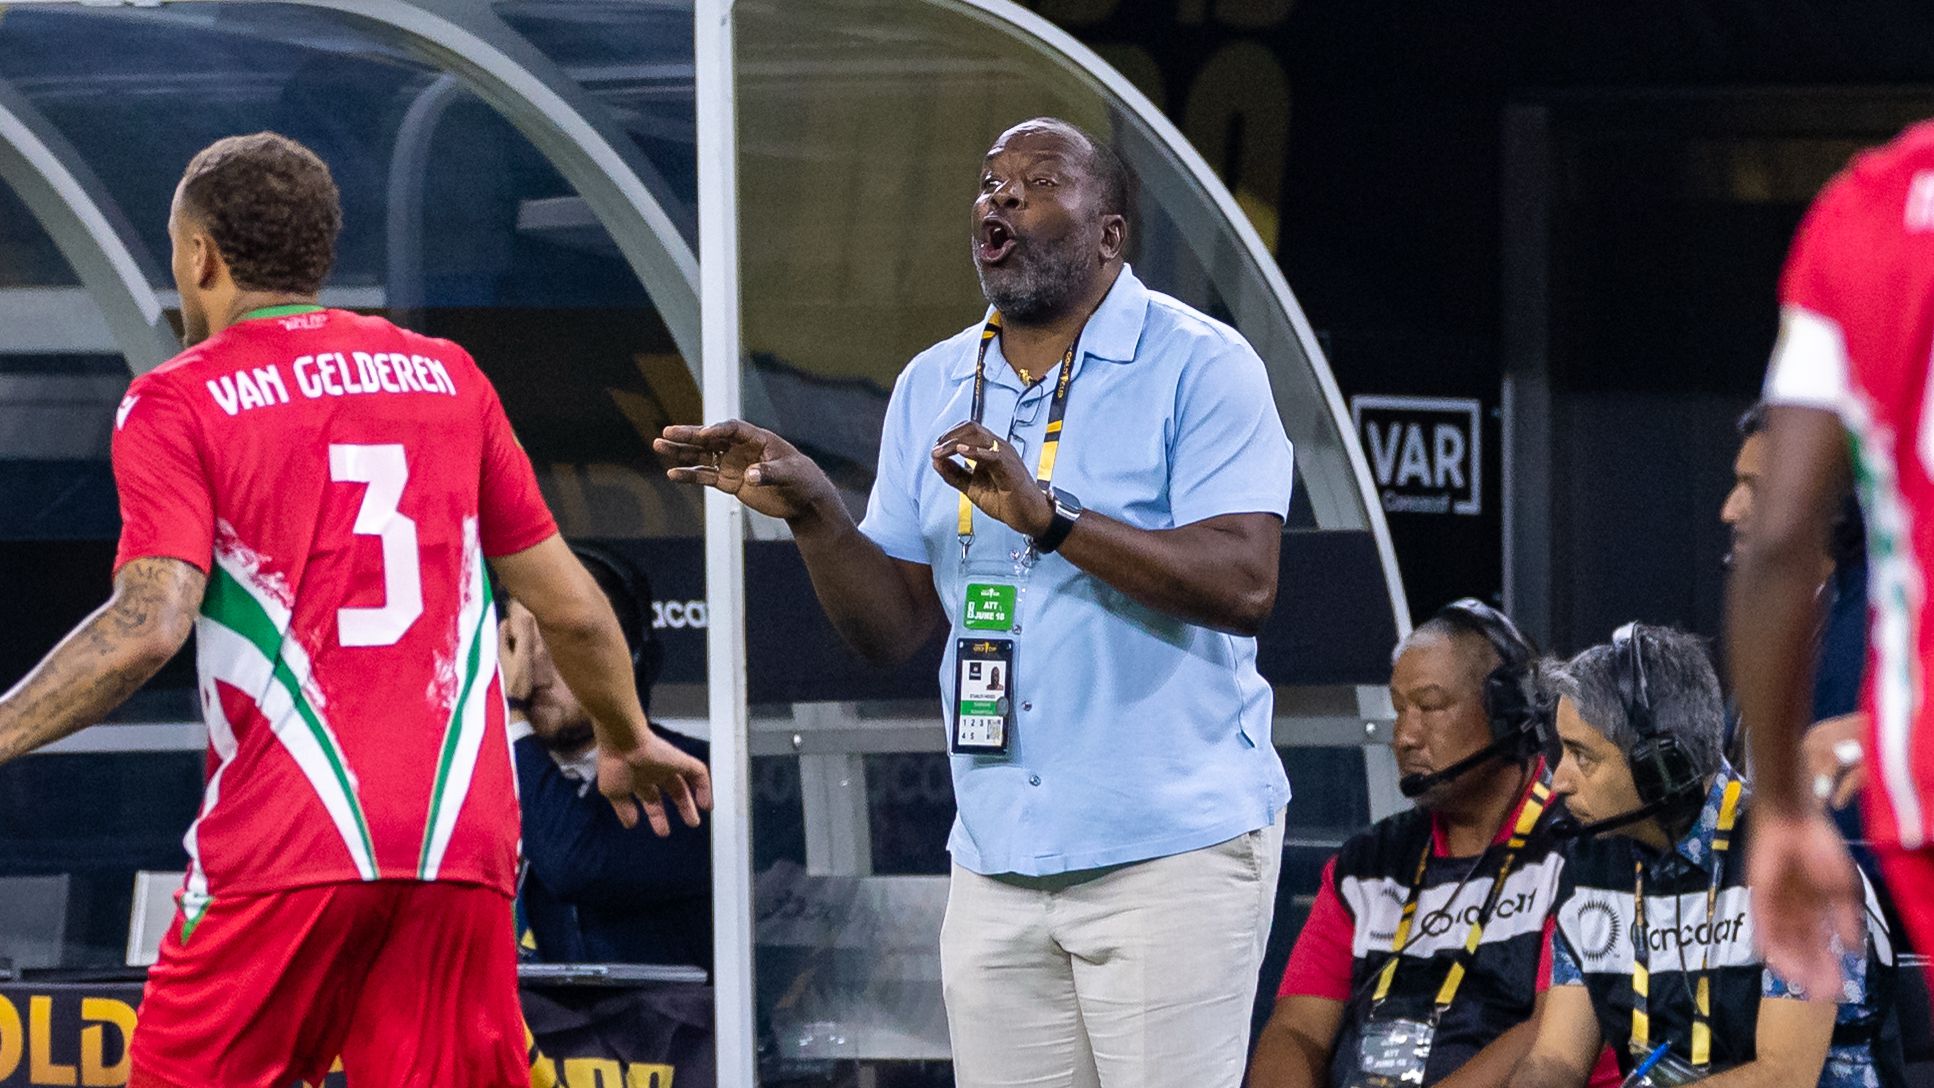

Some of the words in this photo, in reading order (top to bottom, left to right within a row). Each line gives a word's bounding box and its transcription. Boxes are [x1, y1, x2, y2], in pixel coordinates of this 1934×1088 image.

[206, 364, 290, 416] VAN
[293, 351, 457, 398] GELDEREN
[1366, 420, 1466, 489] VAR
[329, 443, 425, 647] 3
[974, 612, 994, 621] JUNE
[983, 601, 998, 610] ATT
